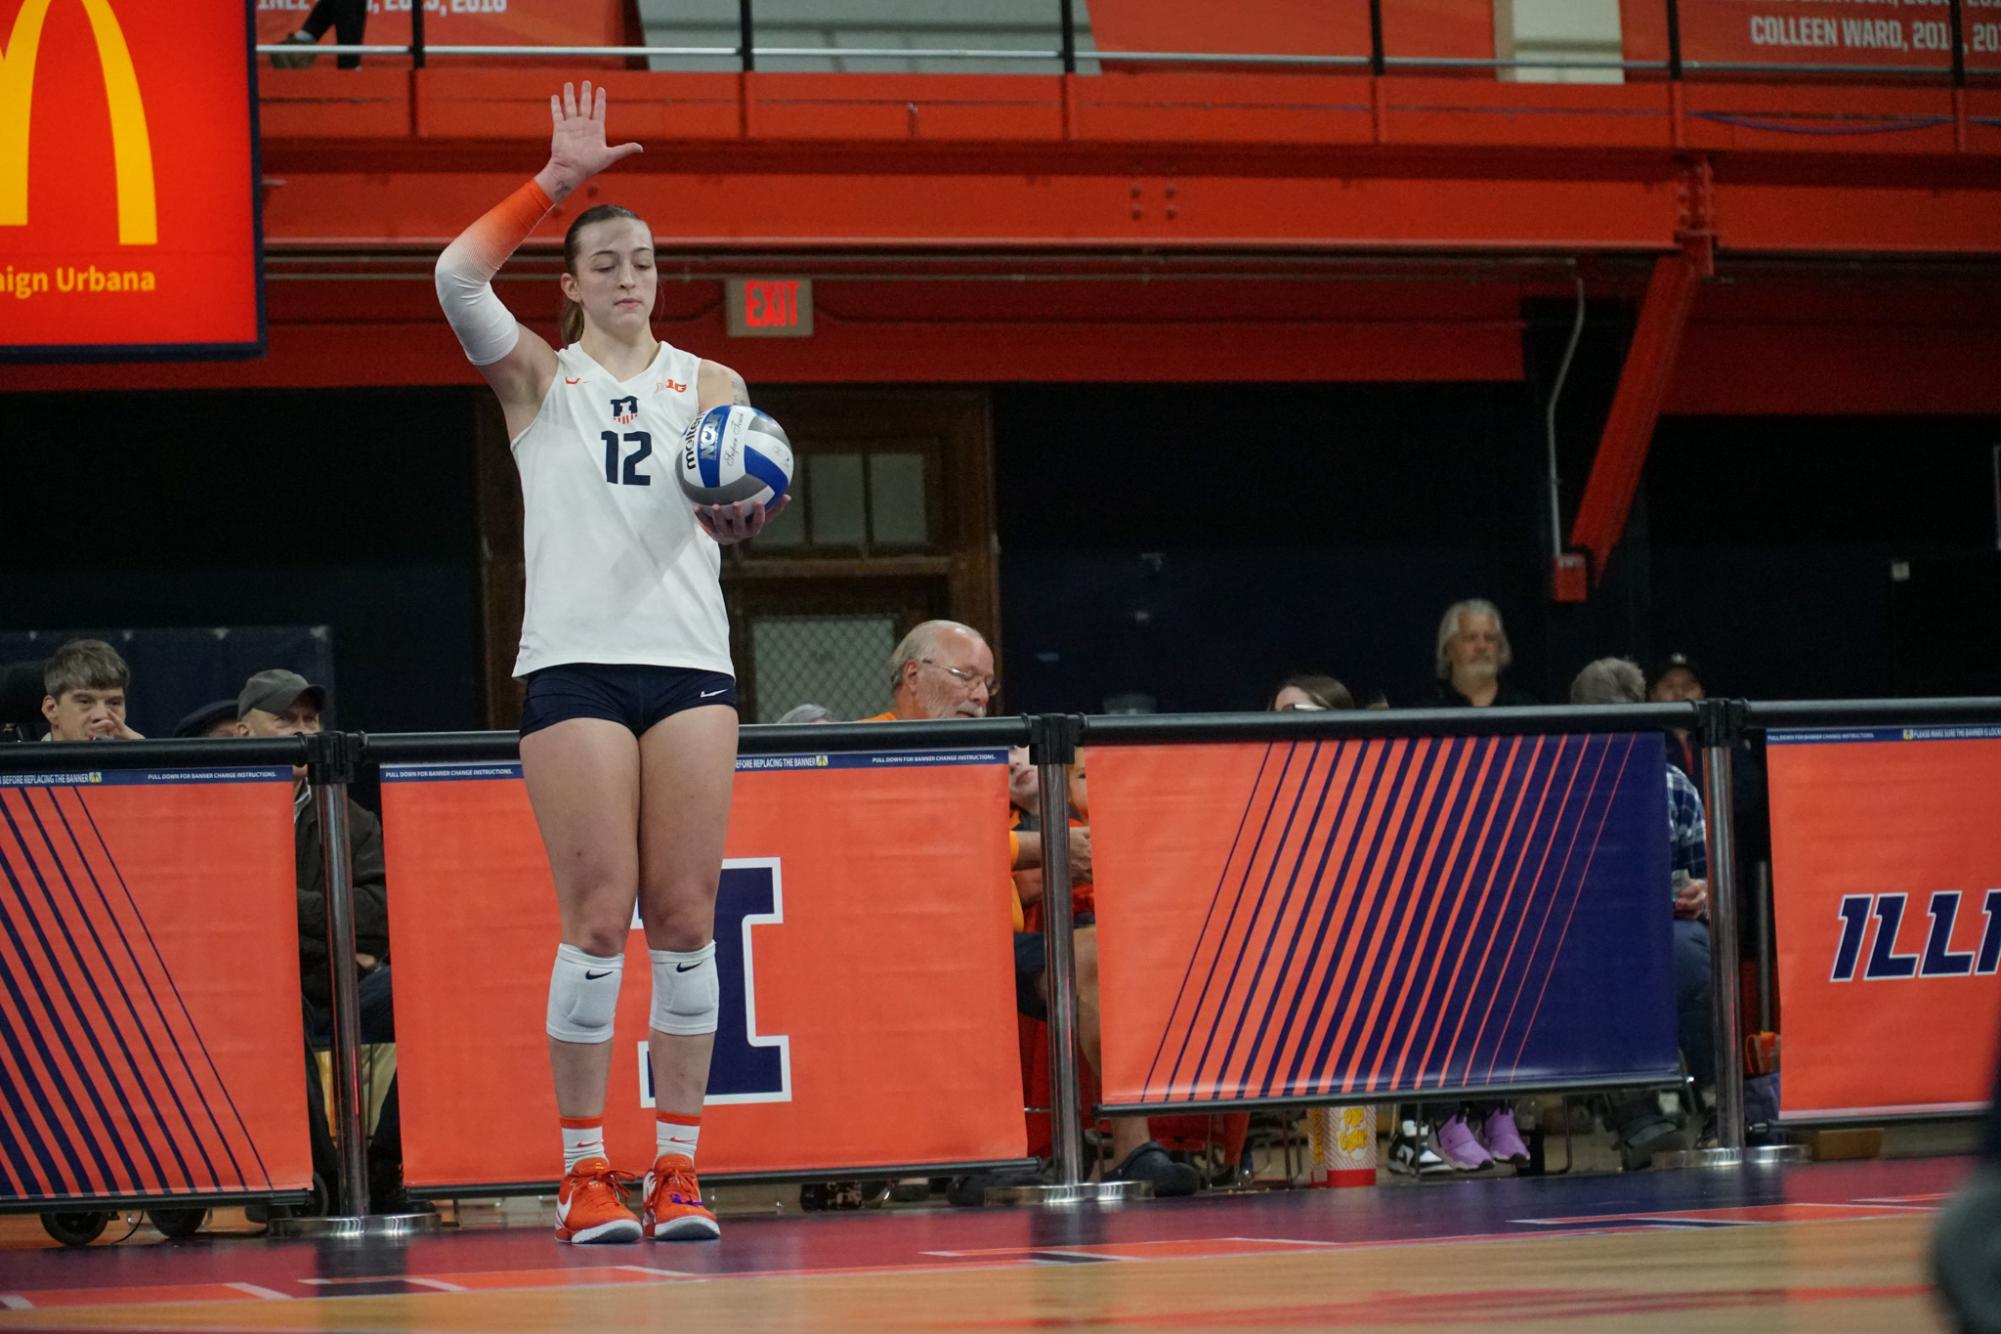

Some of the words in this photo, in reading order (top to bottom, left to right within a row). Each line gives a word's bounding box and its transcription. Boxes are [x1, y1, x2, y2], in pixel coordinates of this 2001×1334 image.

[1750, 16, 1837, 47] COLLEEN
[1841, 18, 1908, 51] WARD,
[1912, 20, 1968, 53] 201,
[56, 265, 156, 292] Urbana
[745, 280, 800, 327] EXIT
[601, 430, 652, 486] 12
[3, 775, 23, 784] BEFORE
[55, 774, 65, 783] THE
[66, 773, 89, 783] BANNER
[736, 759, 752, 768] EFORE
[753, 759, 782, 768] REPLACING
[783, 758, 793, 767] THE
[794, 757, 816, 767] BANNER
